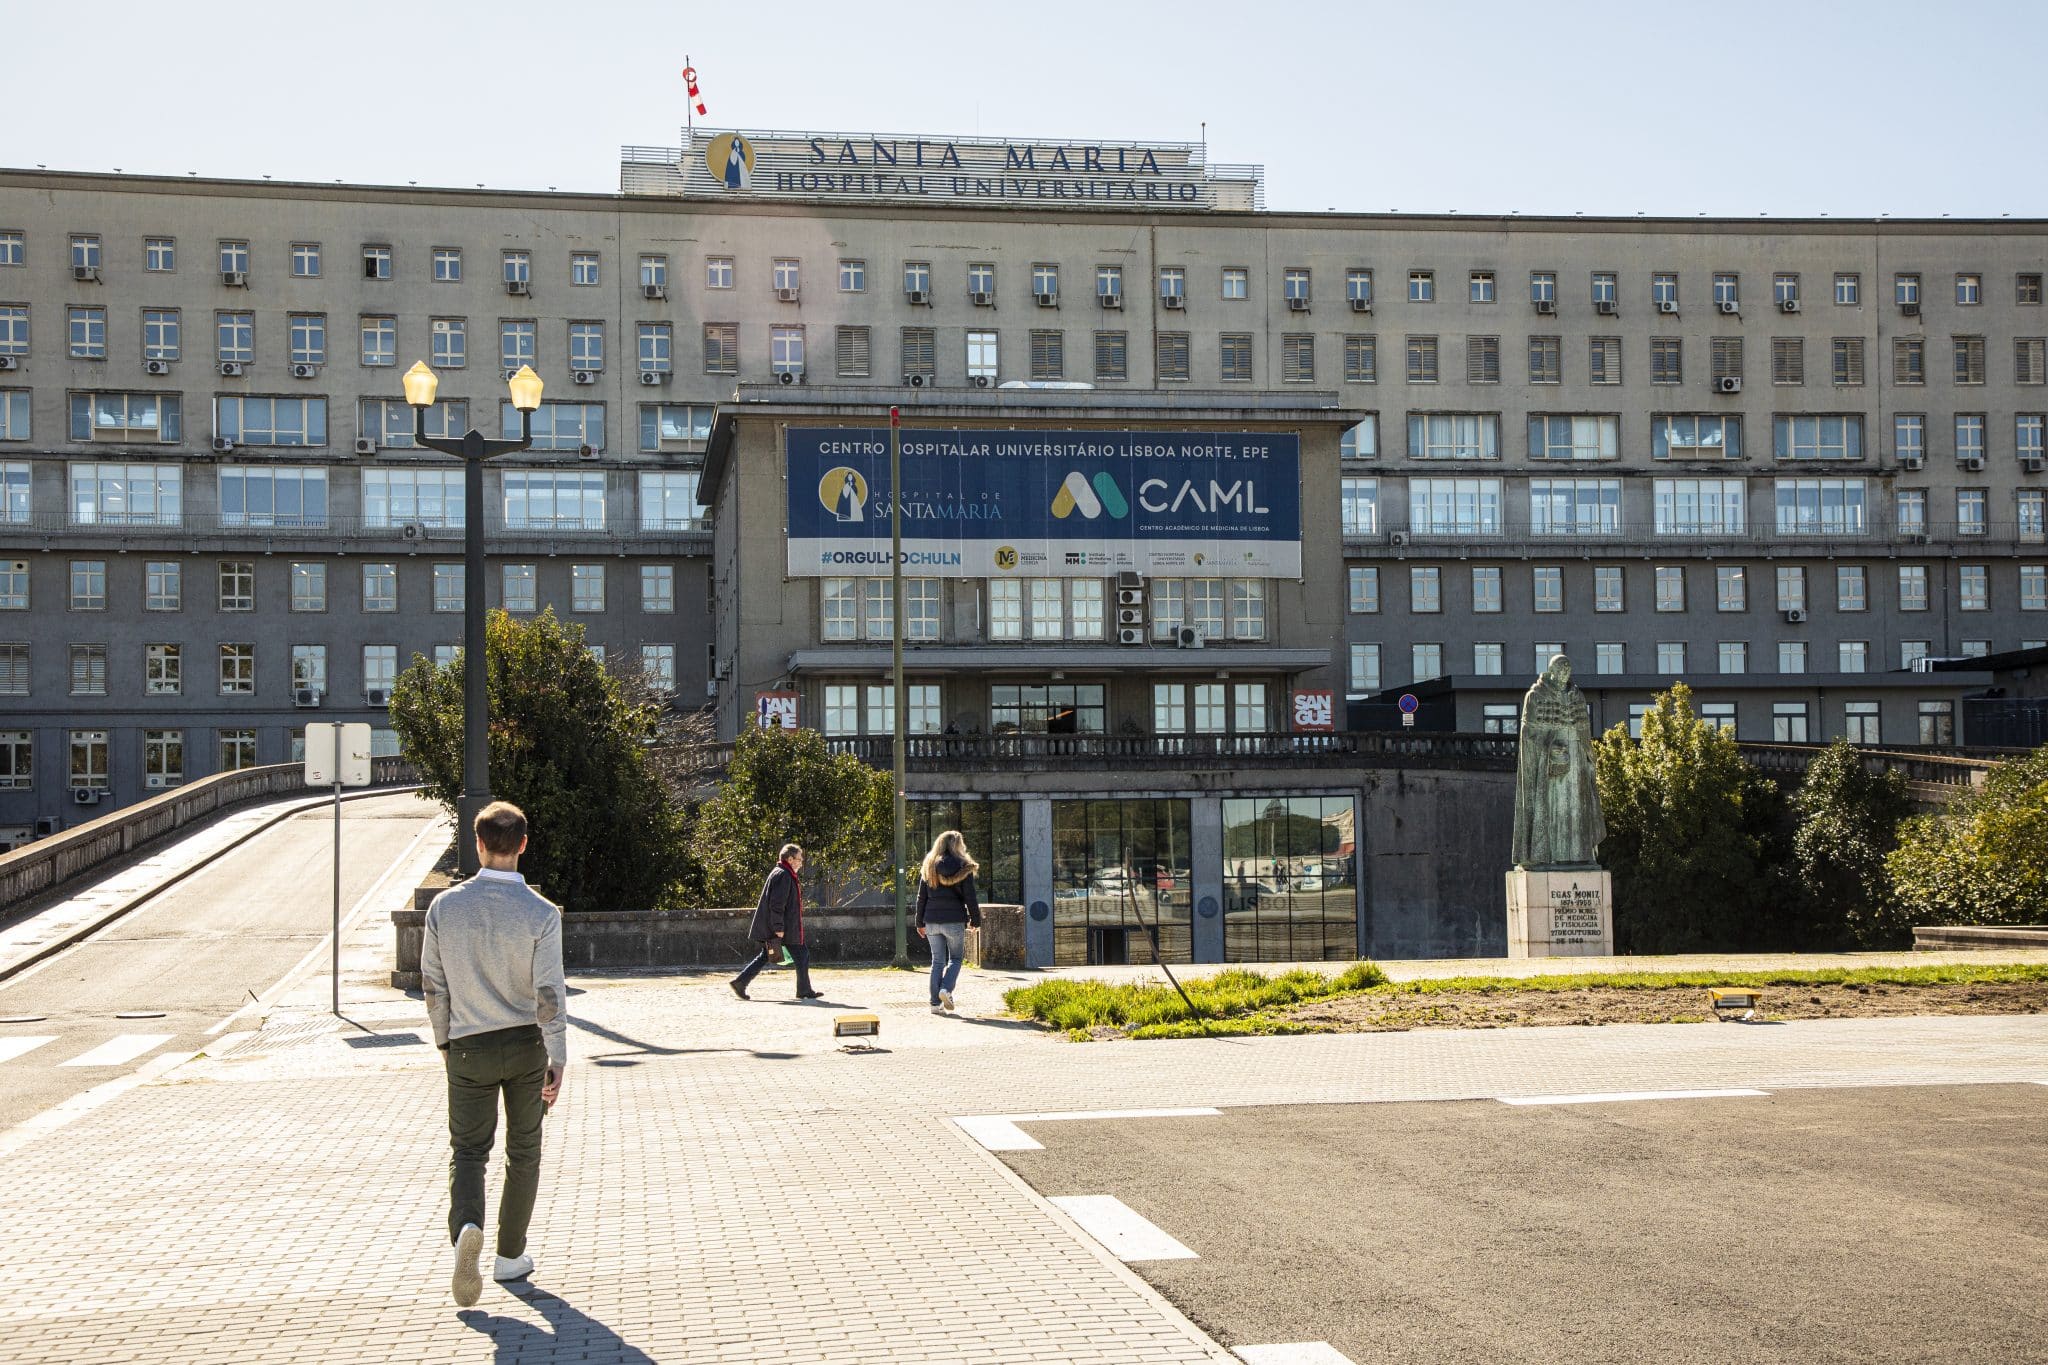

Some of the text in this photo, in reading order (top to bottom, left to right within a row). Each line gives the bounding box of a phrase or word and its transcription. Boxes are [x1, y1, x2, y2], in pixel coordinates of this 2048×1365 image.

[810, 137, 1162, 175] SANTA MARIA
[776, 172, 929, 193] HOSPITAL
[819, 441, 1269, 460] CENTRO OSPITALAR UNIVERSITÁRIO LISBOA NORTE, EPE
[874, 491, 1001, 500] HOSPITAL DE
[1139, 478, 1270, 514] CAML
[874, 501, 1002, 519] SANTAMARIA
[1295, 694, 1331, 711] SAN
[1295, 709, 1331, 725] GUE
[1551, 890, 1600, 899] EGAS MONIZ
[1228, 896, 1299, 911] LISBOA
